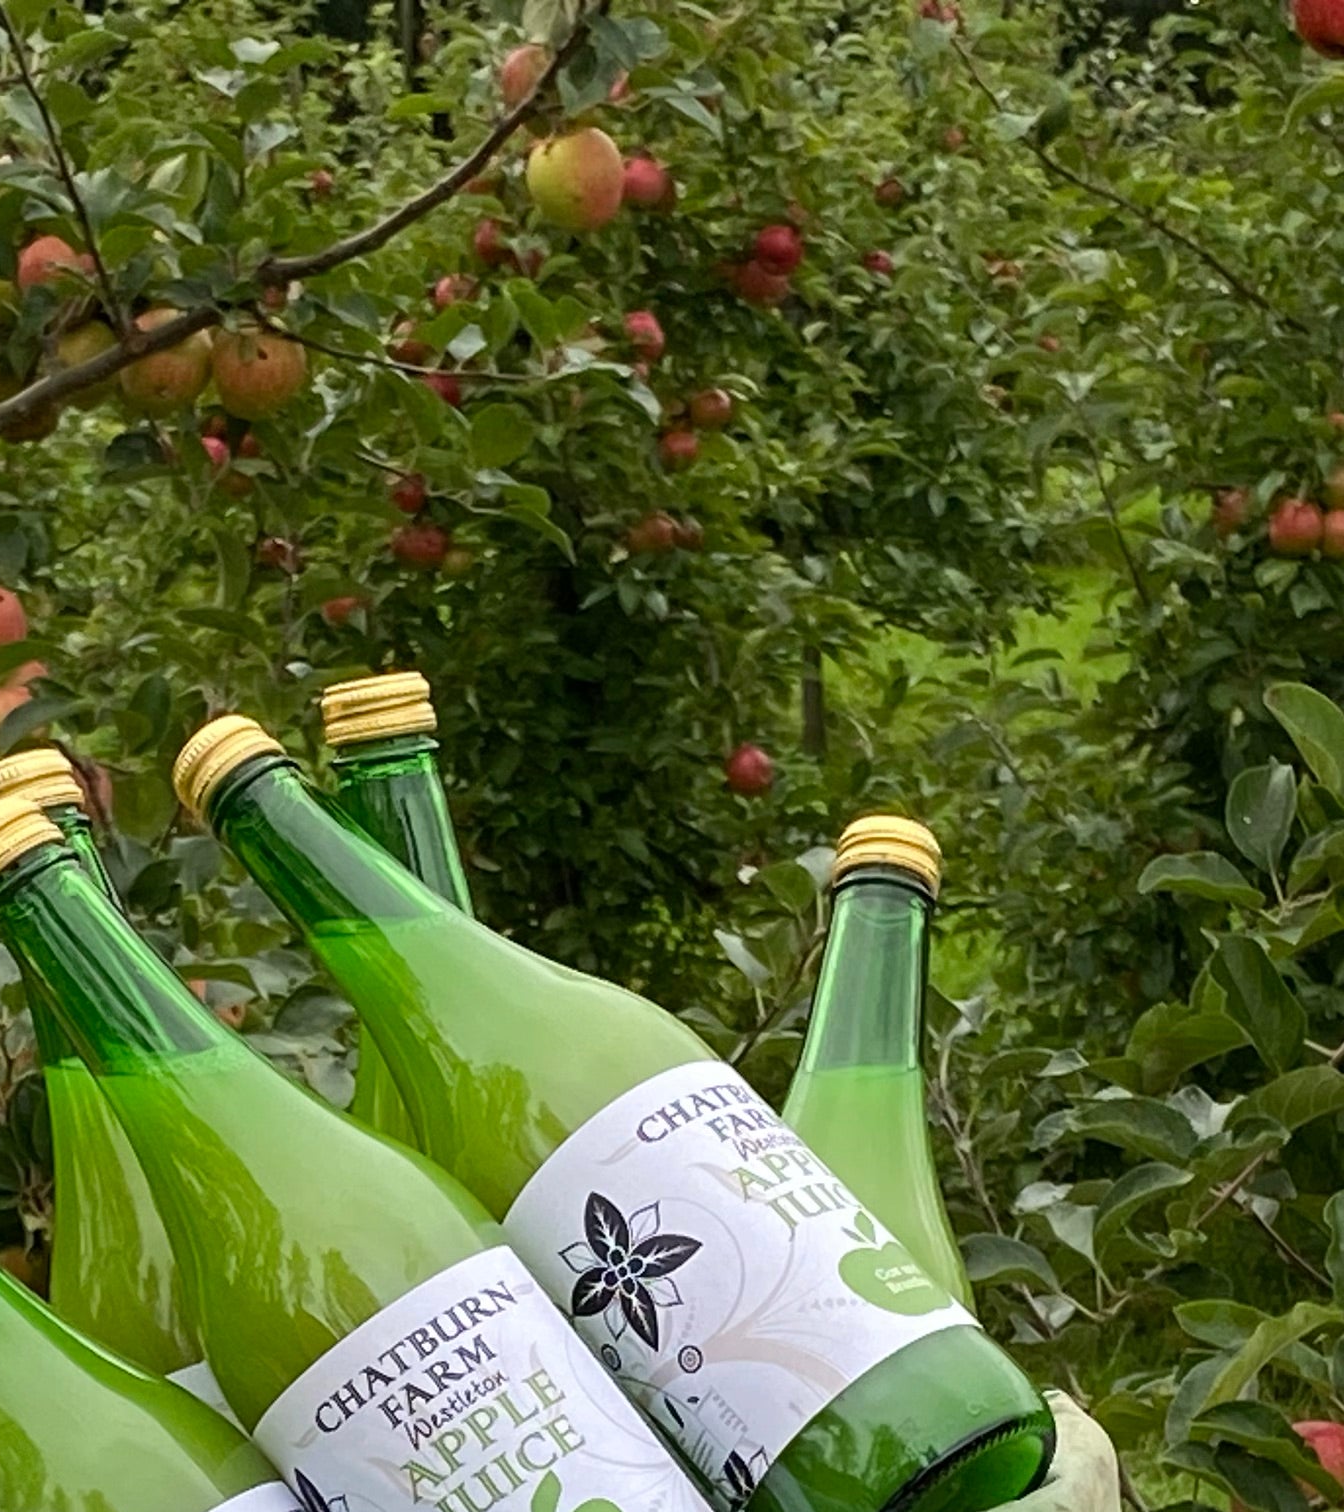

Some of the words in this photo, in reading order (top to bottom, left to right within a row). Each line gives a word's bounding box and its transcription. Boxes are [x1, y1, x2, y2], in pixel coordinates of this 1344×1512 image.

[314, 1280, 519, 1433] CHATBURN
[377, 1333, 498, 1430] FARM
[403, 1371, 510, 1452] Westleton
[400, 1368, 567, 1505] APPLE
